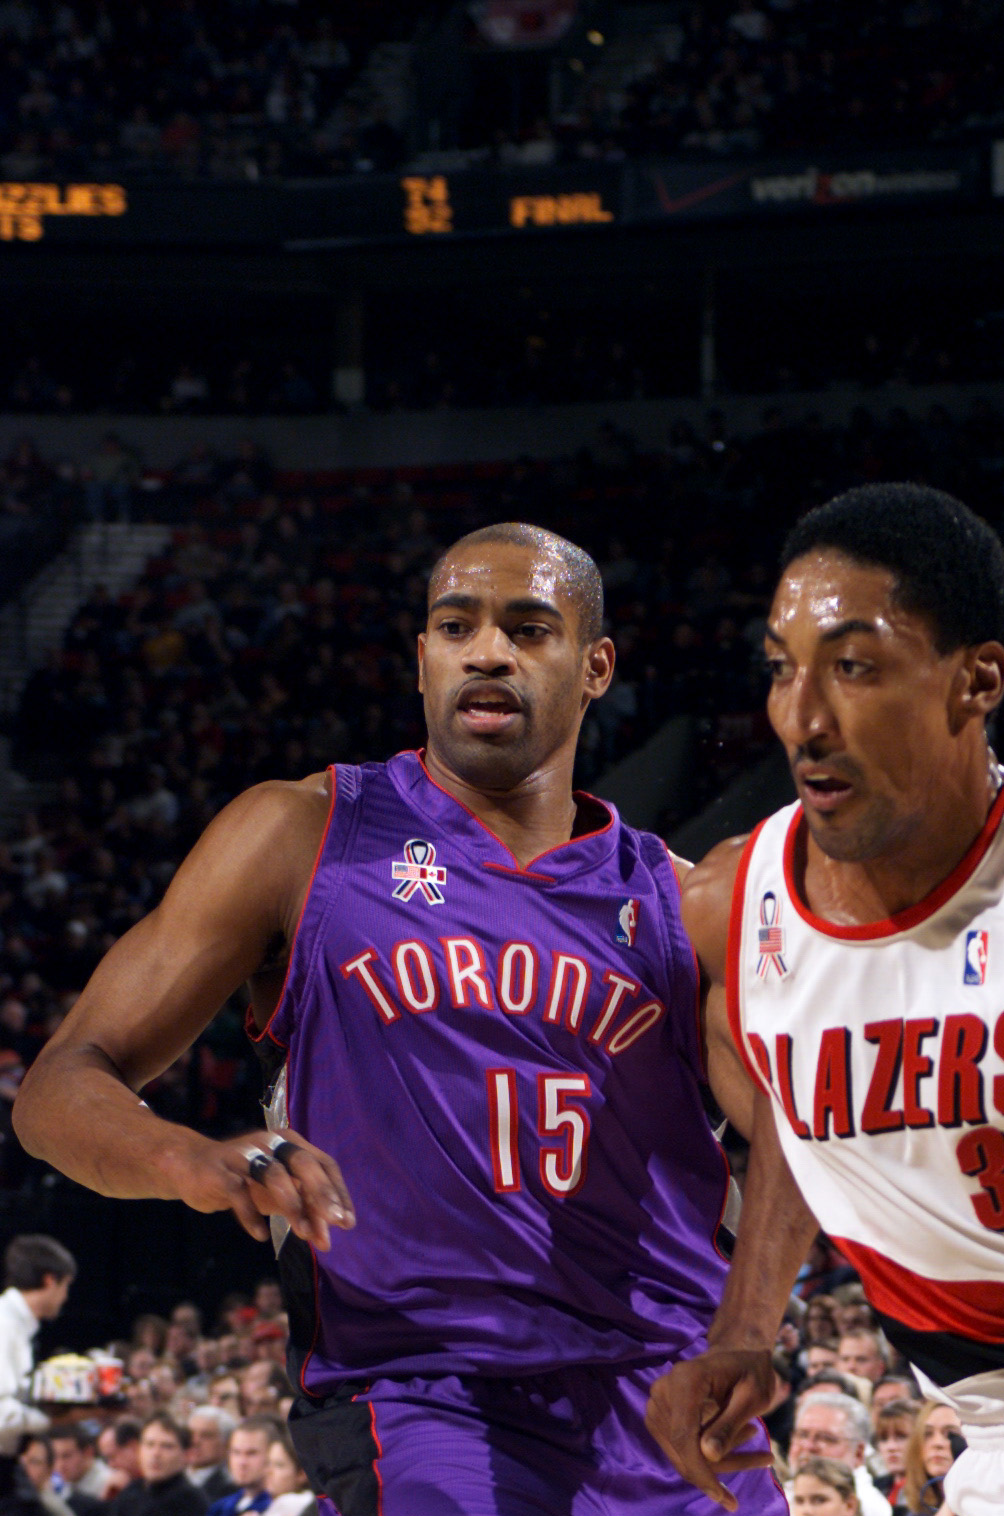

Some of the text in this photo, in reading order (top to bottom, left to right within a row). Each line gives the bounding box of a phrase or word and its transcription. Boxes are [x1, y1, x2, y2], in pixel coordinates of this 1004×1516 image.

[510, 192, 613, 228] FINAL
[753, 166, 876, 204] verizon
[339, 936, 666, 1056] TORONTO
[486, 1067, 592, 1198] 15
